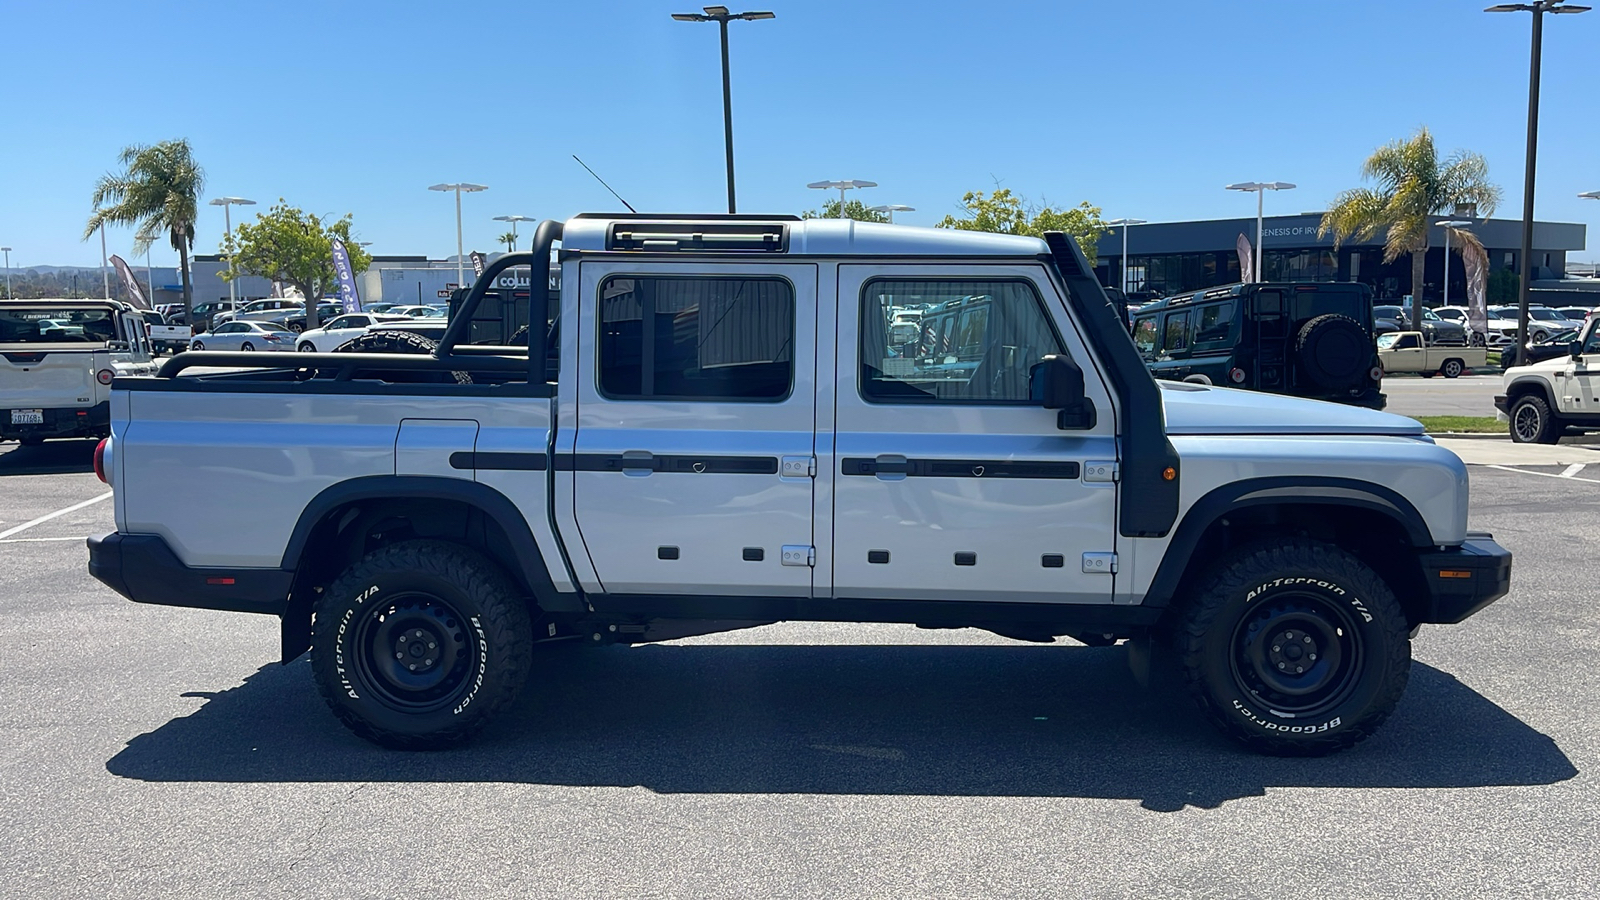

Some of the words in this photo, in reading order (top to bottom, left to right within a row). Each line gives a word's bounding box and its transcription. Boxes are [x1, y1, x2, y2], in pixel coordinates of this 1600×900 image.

[1261, 227, 1290, 236] GENESIS
[1291, 227, 1303, 235] OF
[1304, 226, 1331, 235] IRVE
[500, 277, 556, 287] COLLIN
[1246, 577, 1346, 602] All-Terrain
[1351, 597, 1373, 623] T/A
[336, 609, 360, 699] All-Terrain
[355, 585, 380, 604] T/A
[453, 616, 488, 715] BFGoodrich
[1232, 699, 1342, 734] BFGoodrich
